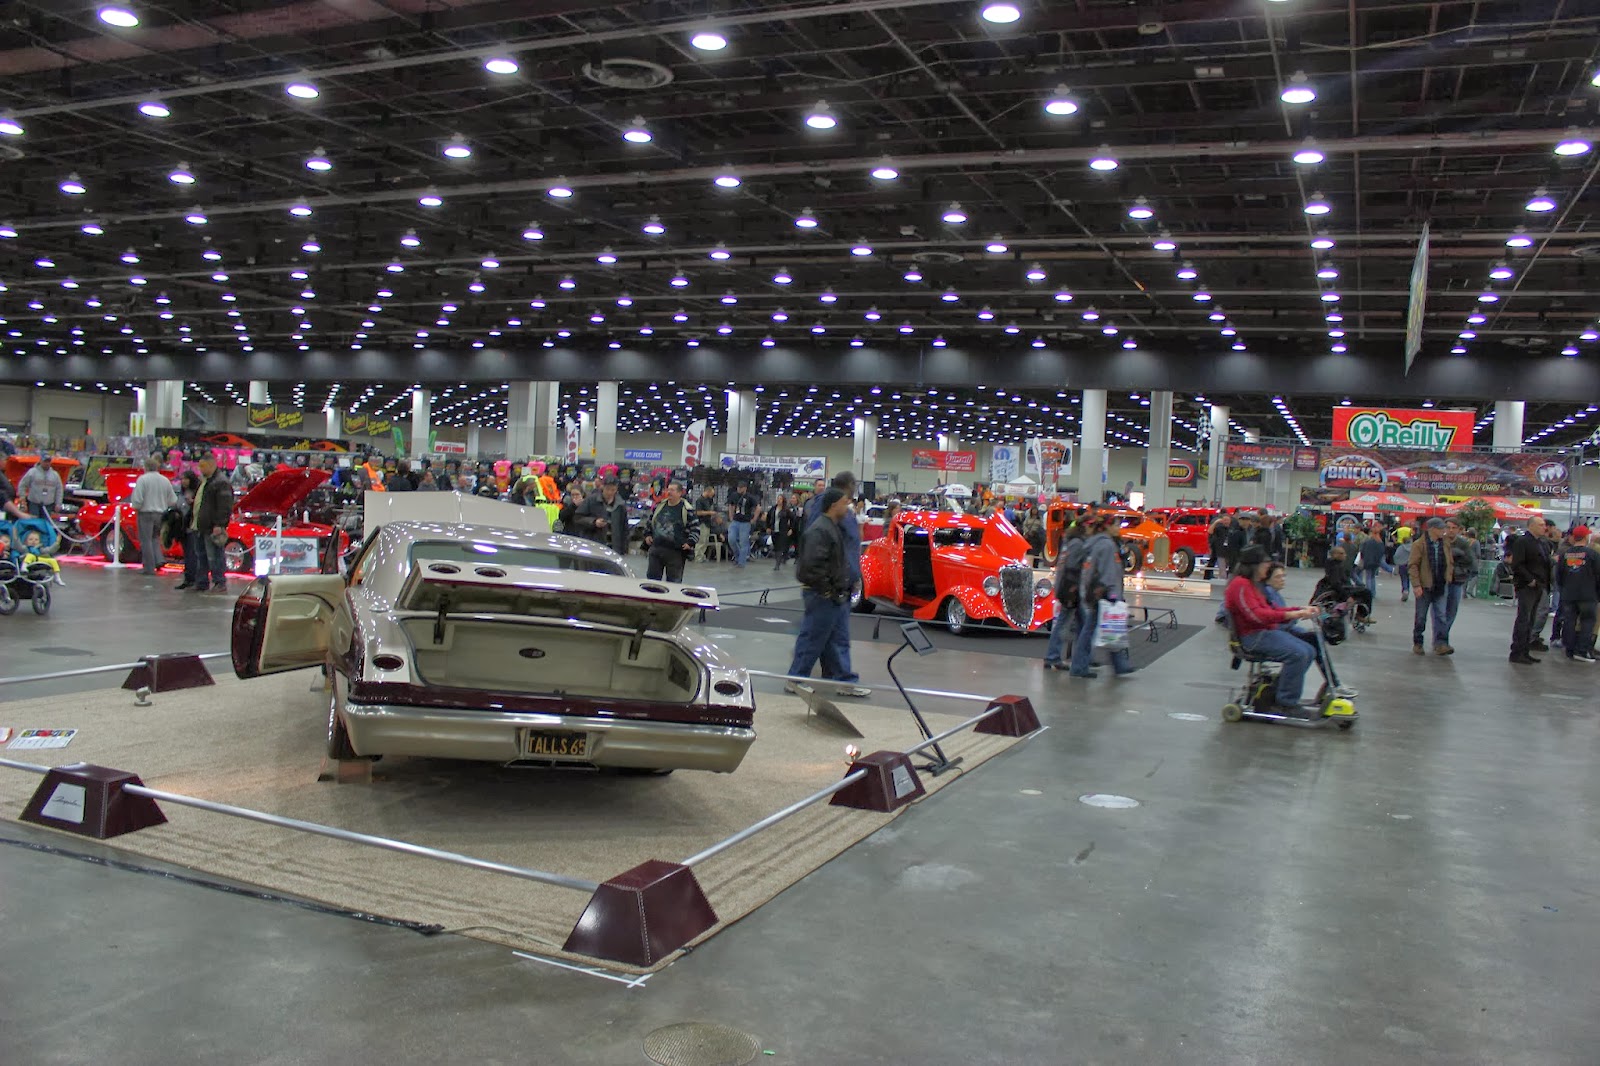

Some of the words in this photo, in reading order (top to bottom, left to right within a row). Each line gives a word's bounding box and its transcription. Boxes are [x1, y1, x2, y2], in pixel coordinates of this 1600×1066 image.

[1352, 416, 1450, 452] O'Reilly
[1228, 444, 1262, 454] DRAG
[1264, 446, 1292, 456] CITY
[1327, 465, 1380, 480] BRICKS
[1431, 481, 1457, 490] CHROME
[1465, 483, 1481, 491] FAST
[1482, 483, 1501, 492] CARS
[1533, 486, 1568, 494] BUICK
[528, 736, 568, 755] TALLS
[570, 738, 586, 755] 65
